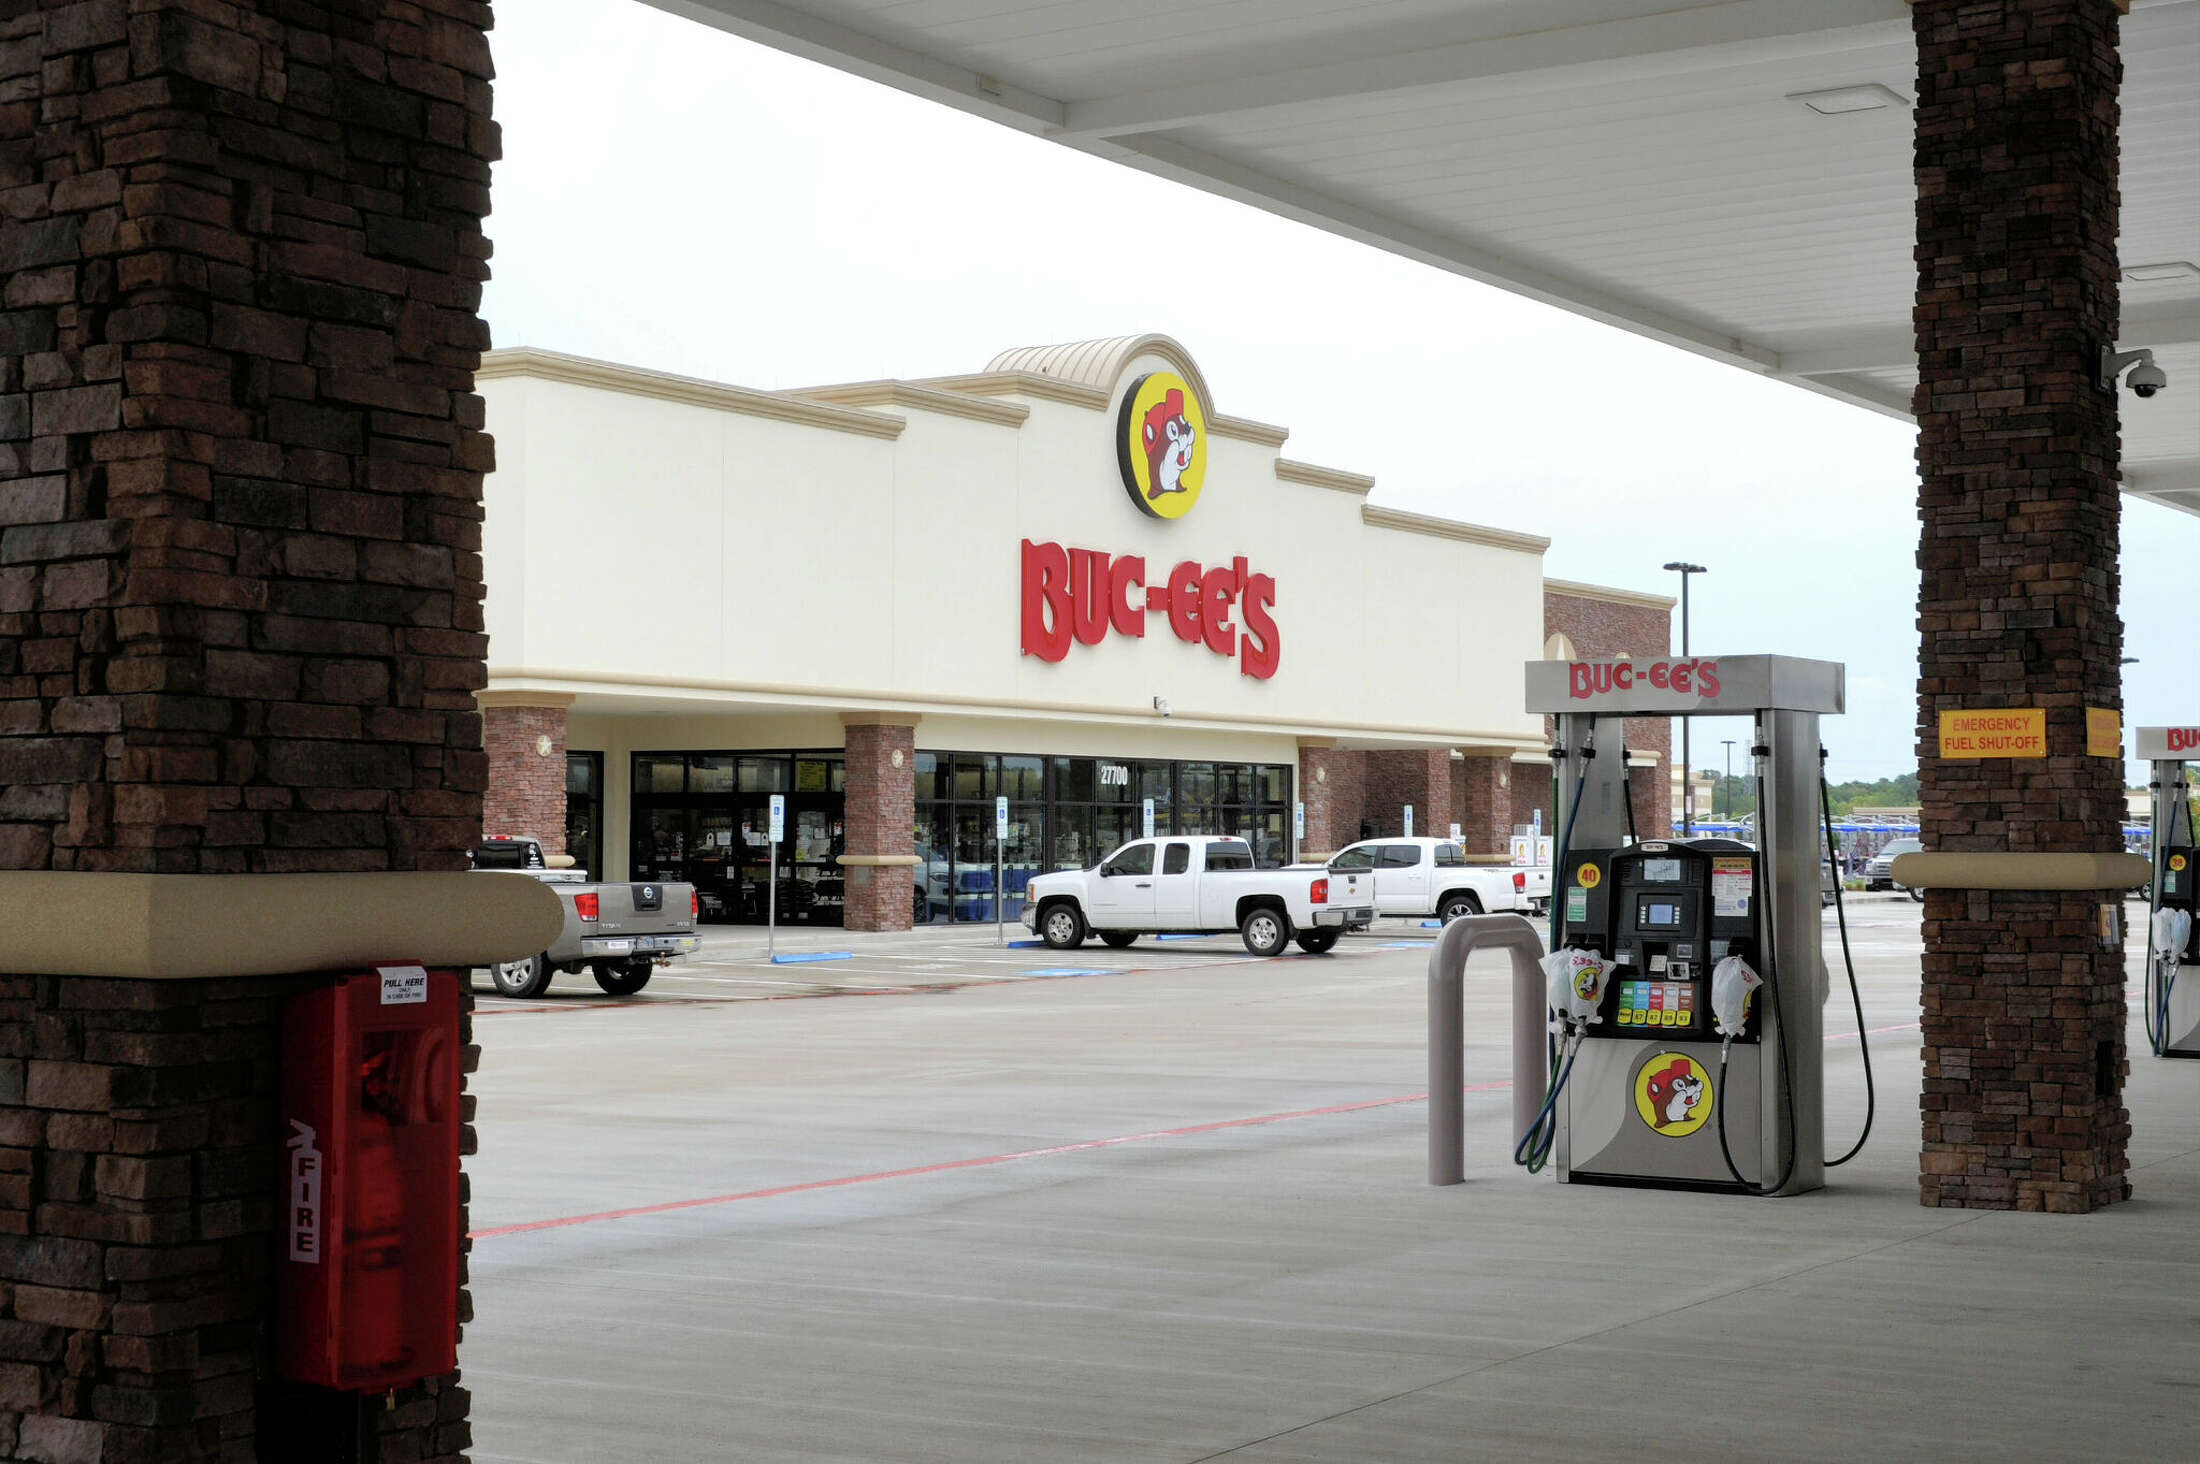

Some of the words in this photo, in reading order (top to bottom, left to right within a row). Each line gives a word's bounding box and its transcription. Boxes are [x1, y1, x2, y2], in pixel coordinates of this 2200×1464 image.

[1021, 538, 1280, 680] BUC-EE'S
[1569, 658, 1721, 699] BUC-EE'S
[1953, 717, 2031, 731] EMERGENCY
[1944, 737, 1976, 750] FUEL
[1979, 736, 2040, 750] SHUT-OFF
[2167, 727, 2200, 752] BU
[1100, 765, 1128, 785] 27700
[1582, 868, 1597, 882] 40
[384, 979, 402, 988] PULL
[405, 977, 425, 987] HERE
[297, 1157, 315, 1252] FIRE
